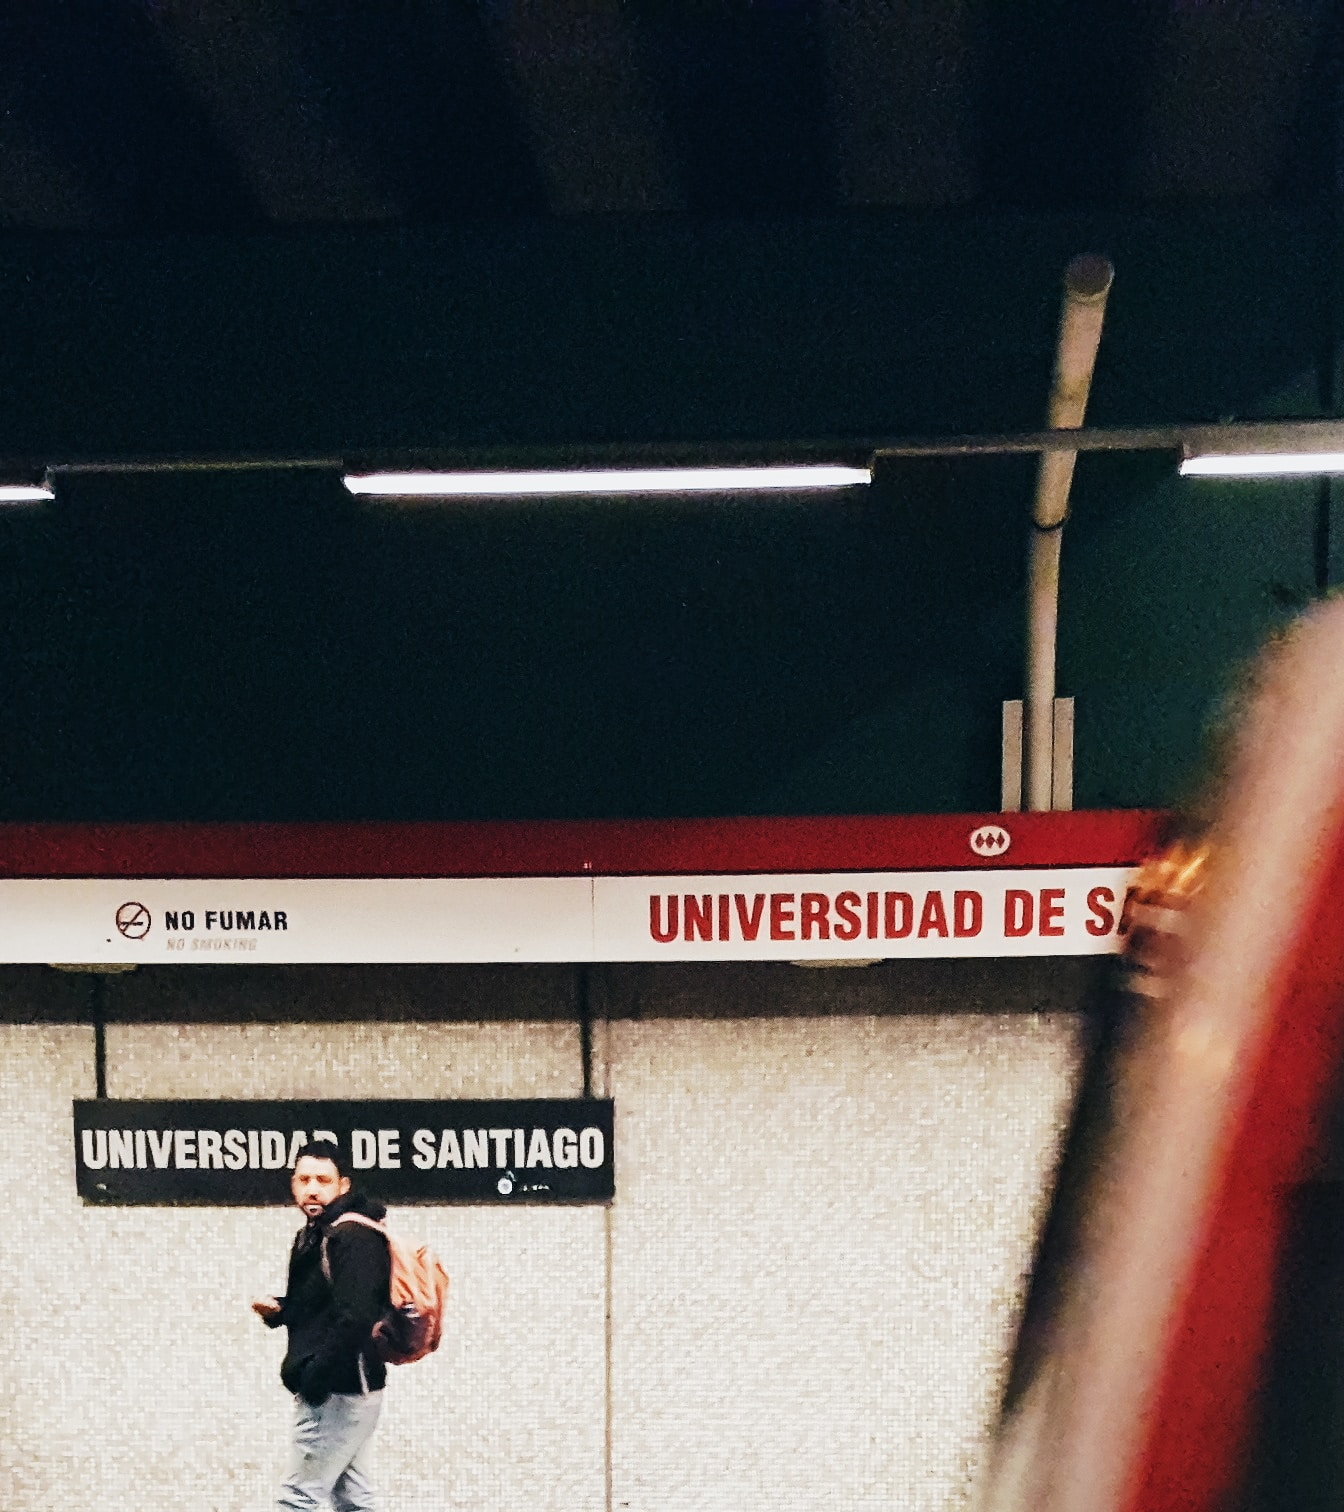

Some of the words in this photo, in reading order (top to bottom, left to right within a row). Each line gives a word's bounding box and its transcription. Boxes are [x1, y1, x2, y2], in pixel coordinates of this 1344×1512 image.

[165, 910, 195, 931] NO
[205, 910, 288, 931] FUMAR
[649, 889, 983, 943] UNIVERSIDAD
[1003, 888, 1065, 937] DE
[351, 1129, 401, 1169] DE
[412, 1127, 605, 1170] SANTIAGO
